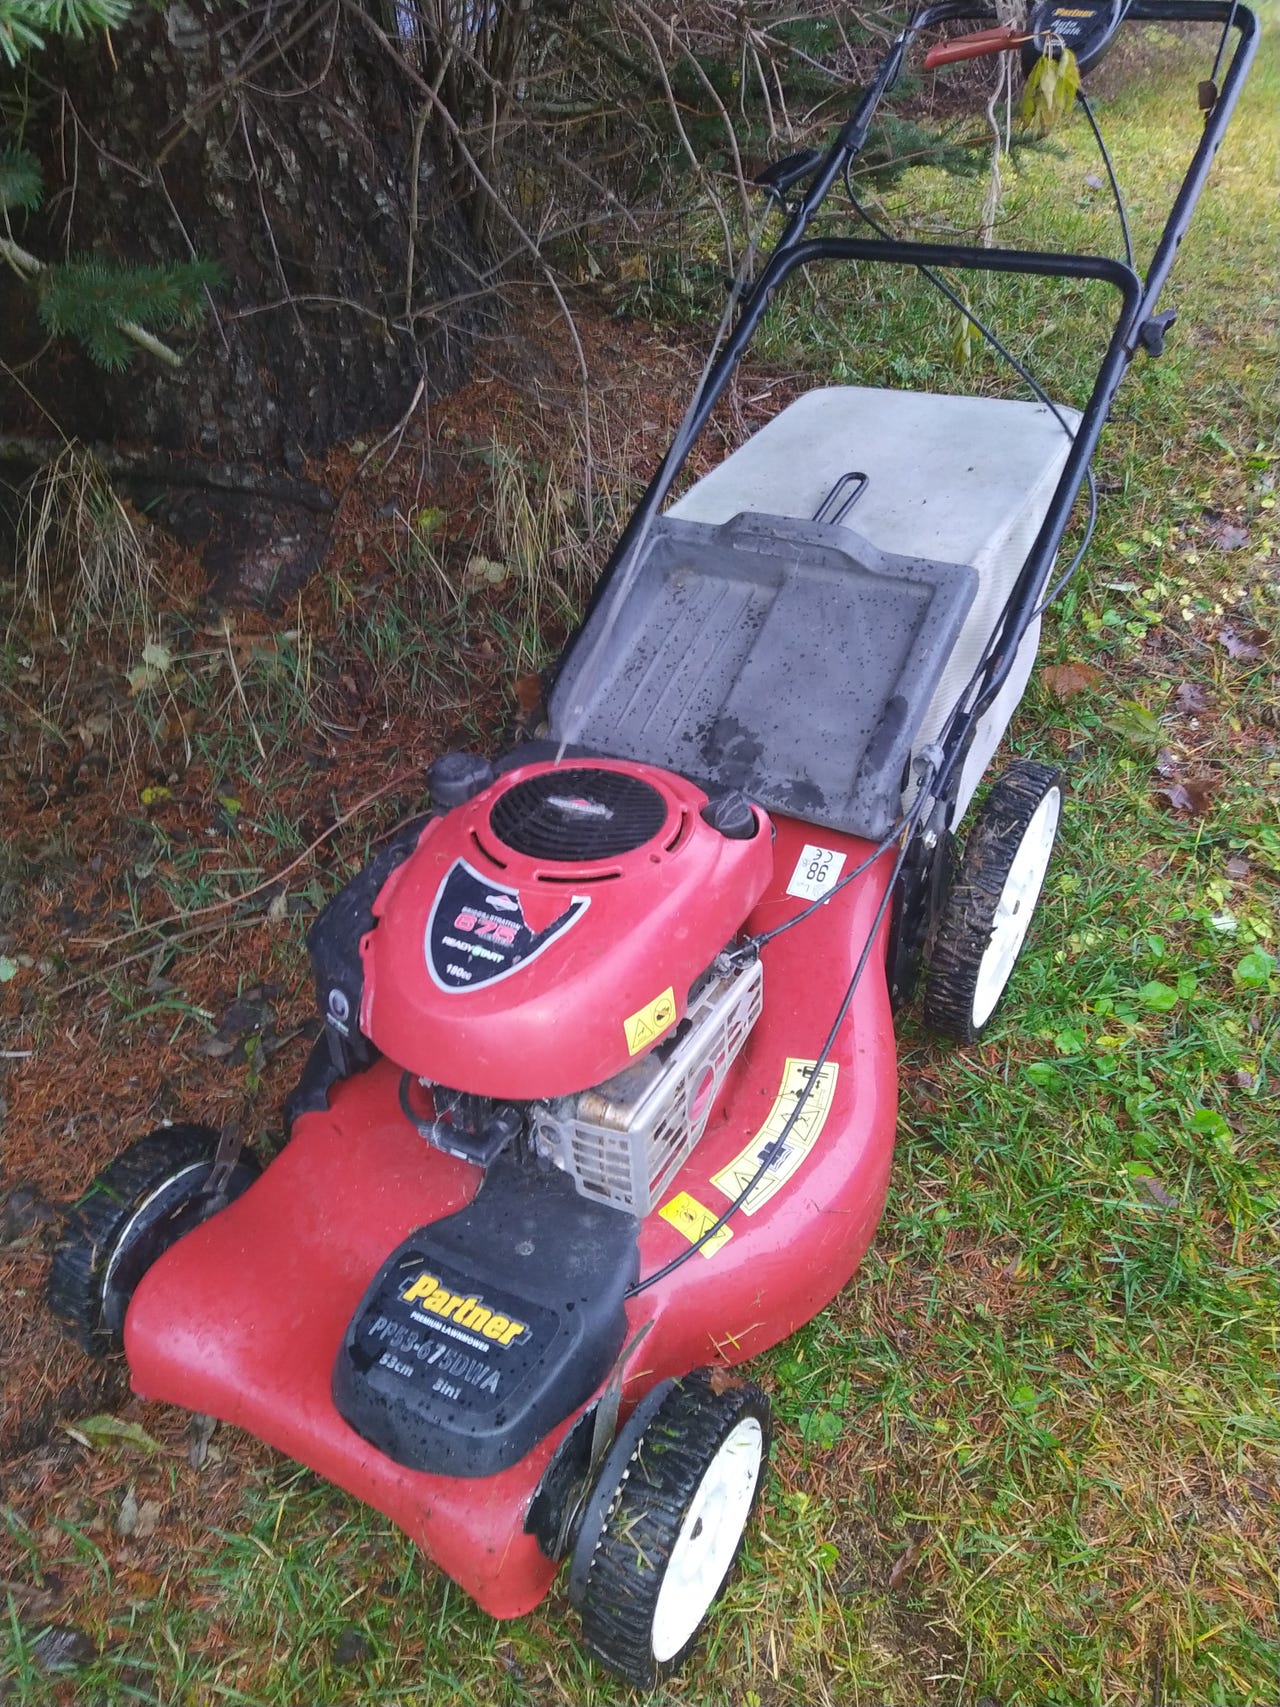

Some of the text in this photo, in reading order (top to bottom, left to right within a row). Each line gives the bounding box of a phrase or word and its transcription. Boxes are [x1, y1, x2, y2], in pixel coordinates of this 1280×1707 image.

[1050, 19, 1078, 28] Auto
[1054, 26, 1081, 36] Walk
[402, 1272, 525, 1346] Partner
[409, 1310, 490, 1353] PREMIUM LAWNMOWER
[367, 1315, 503, 1395] PP53-675DWA
[378, 1352, 462, 1401] 53cm 3in1
